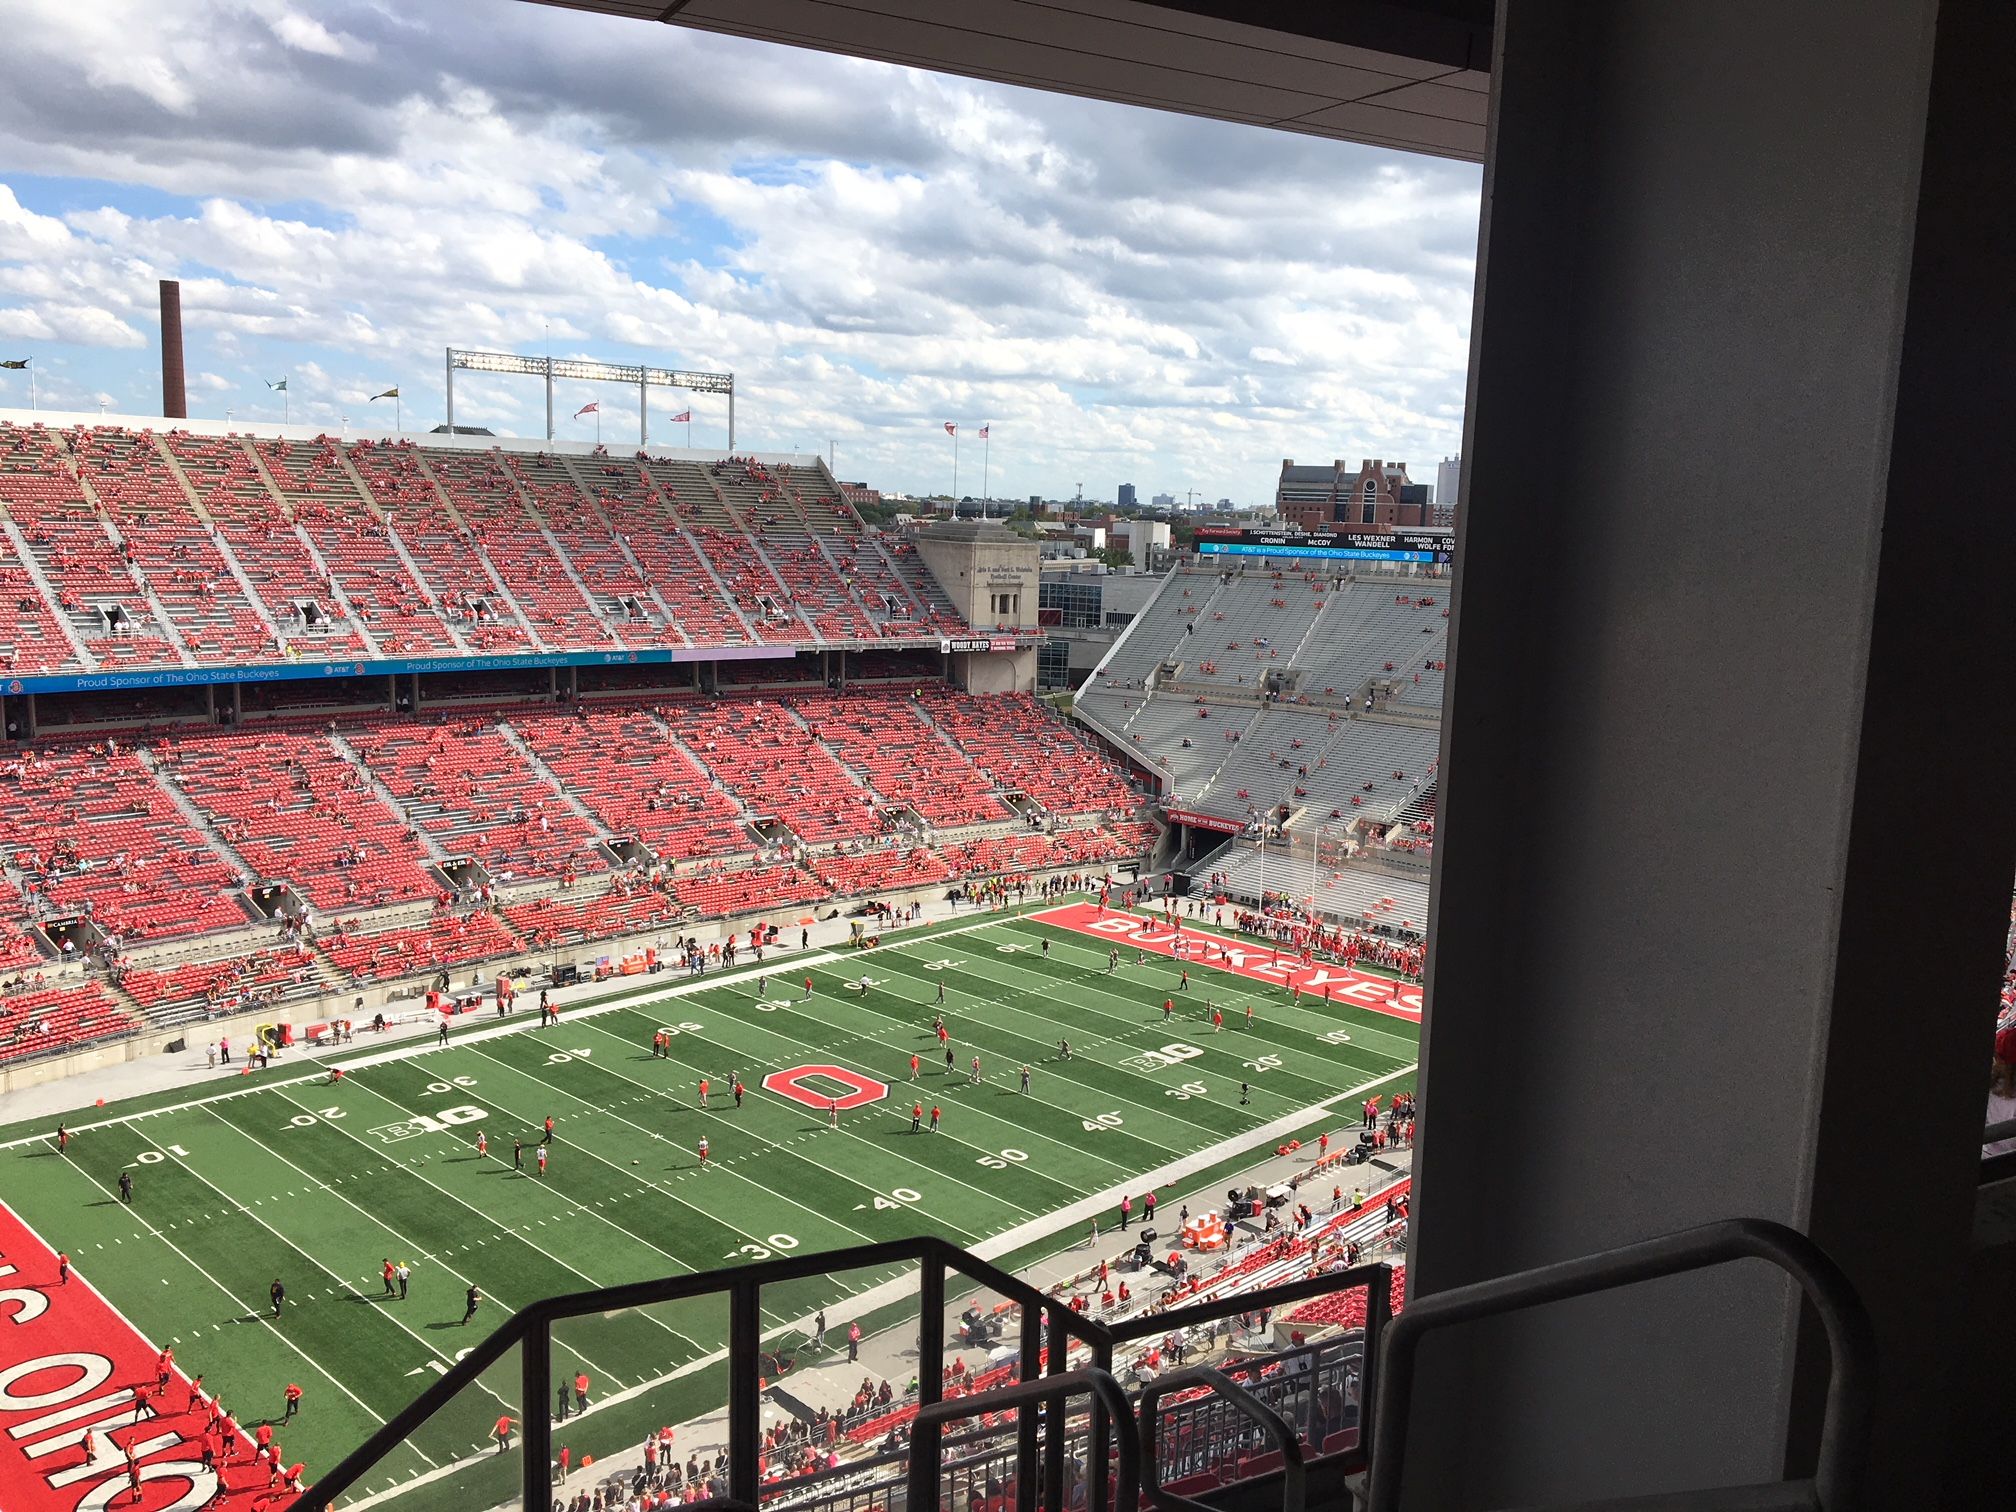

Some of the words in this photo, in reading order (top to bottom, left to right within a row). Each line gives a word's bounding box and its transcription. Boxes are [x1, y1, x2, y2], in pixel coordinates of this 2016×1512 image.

[1404, 536, 1433, 544] HARMON
[1284, 548, 1309, 556] Sponsor
[1360, 550, 1390, 559] Buckeyes
[972, 641, 990, 649] HAYES
[406, 661, 431, 671] Proud
[432, 660, 465, 671] Sponsor
[466, 659, 476, 668] of
[476, 659, 491, 668] The
[492, 658, 511, 667] Ohio
[512, 657, 533, 666] State
[534, 655, 568, 666] Buckeyes
[612, 654, 625, 662] AT&T
[77, 676, 108, 688] Proud
[110, 676, 149, 687] Sponsor
[153, 674, 164, 683] of
[166, 673, 184, 683] The
[186, 672, 209, 682] Ohio
[210, 671, 236, 680] State
[237, 669, 279, 681] Buckeyes
[1180, 814, 1197, 823] HOME
[1209, 820, 1240, 831] BUCKEYES
[53, 920, 78, 928] CAMBRIA
[1086, 917, 1423, 1014] BUCKEYES
[755, 999, 792, 1012] 40
[657, 1021, 705, 1036] 50
[1315, 1030, 1352, 1045] 10
[548, 1047, 592, 1063] 40
[1242, 1055, 1284, 1073] 20
[426, 1075, 479, 1093] 30
[1164, 1081, 1208, 1101] 30
[290, 1106, 348, 1127] 20
[1081, 1112, 1124, 1132] 40
[136, 1144, 191, 1164] 10
[975, 1148, 1029, 1170] 50
[873, 1187, 922, 1211] 40
[739, 1233, 800, 1260] 30
[0, 1351, 219, 1512] OHIO
